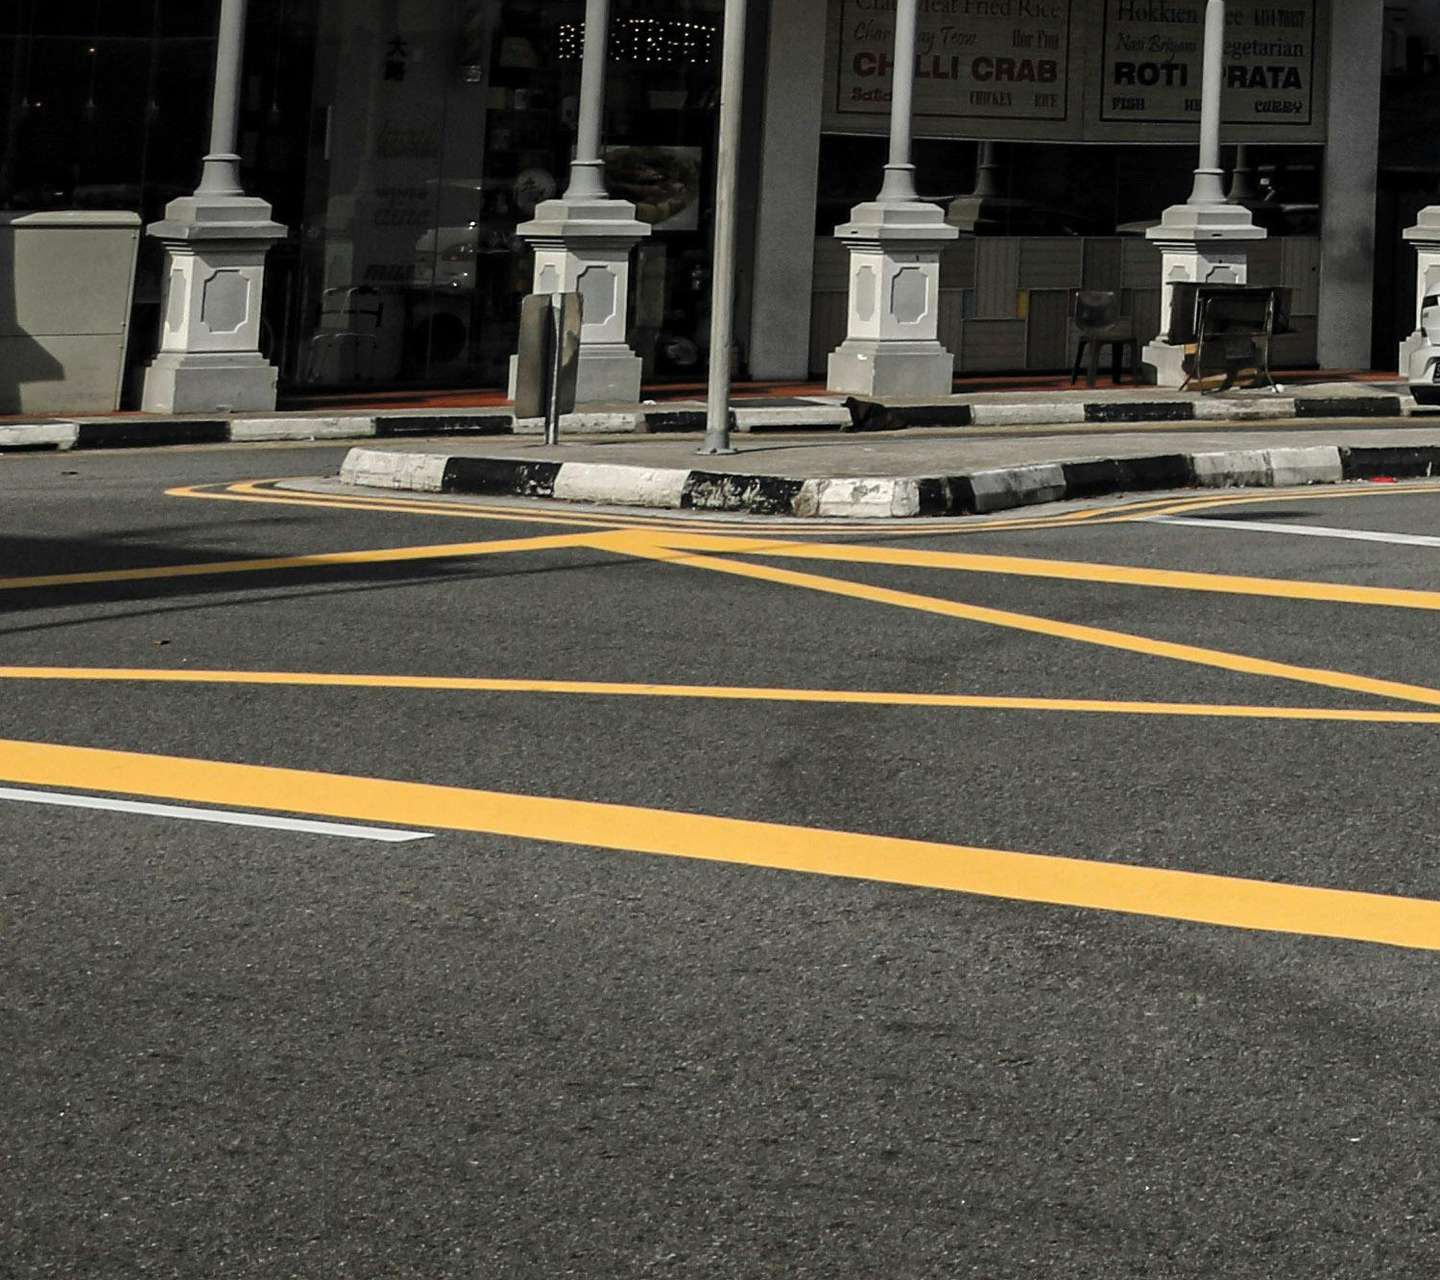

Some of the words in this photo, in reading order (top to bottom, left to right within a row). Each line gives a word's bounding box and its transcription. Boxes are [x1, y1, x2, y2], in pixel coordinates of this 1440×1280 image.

[1223, 37, 1305, 61] egetarian
[852, 51, 959, 81] CHLLI
[971, 56, 1058, 83] CRAB
[1114, 61, 1188, 87] ROTI
[1222, 65, 1302, 90] RATA
[851, 86, 892, 104] Sata
